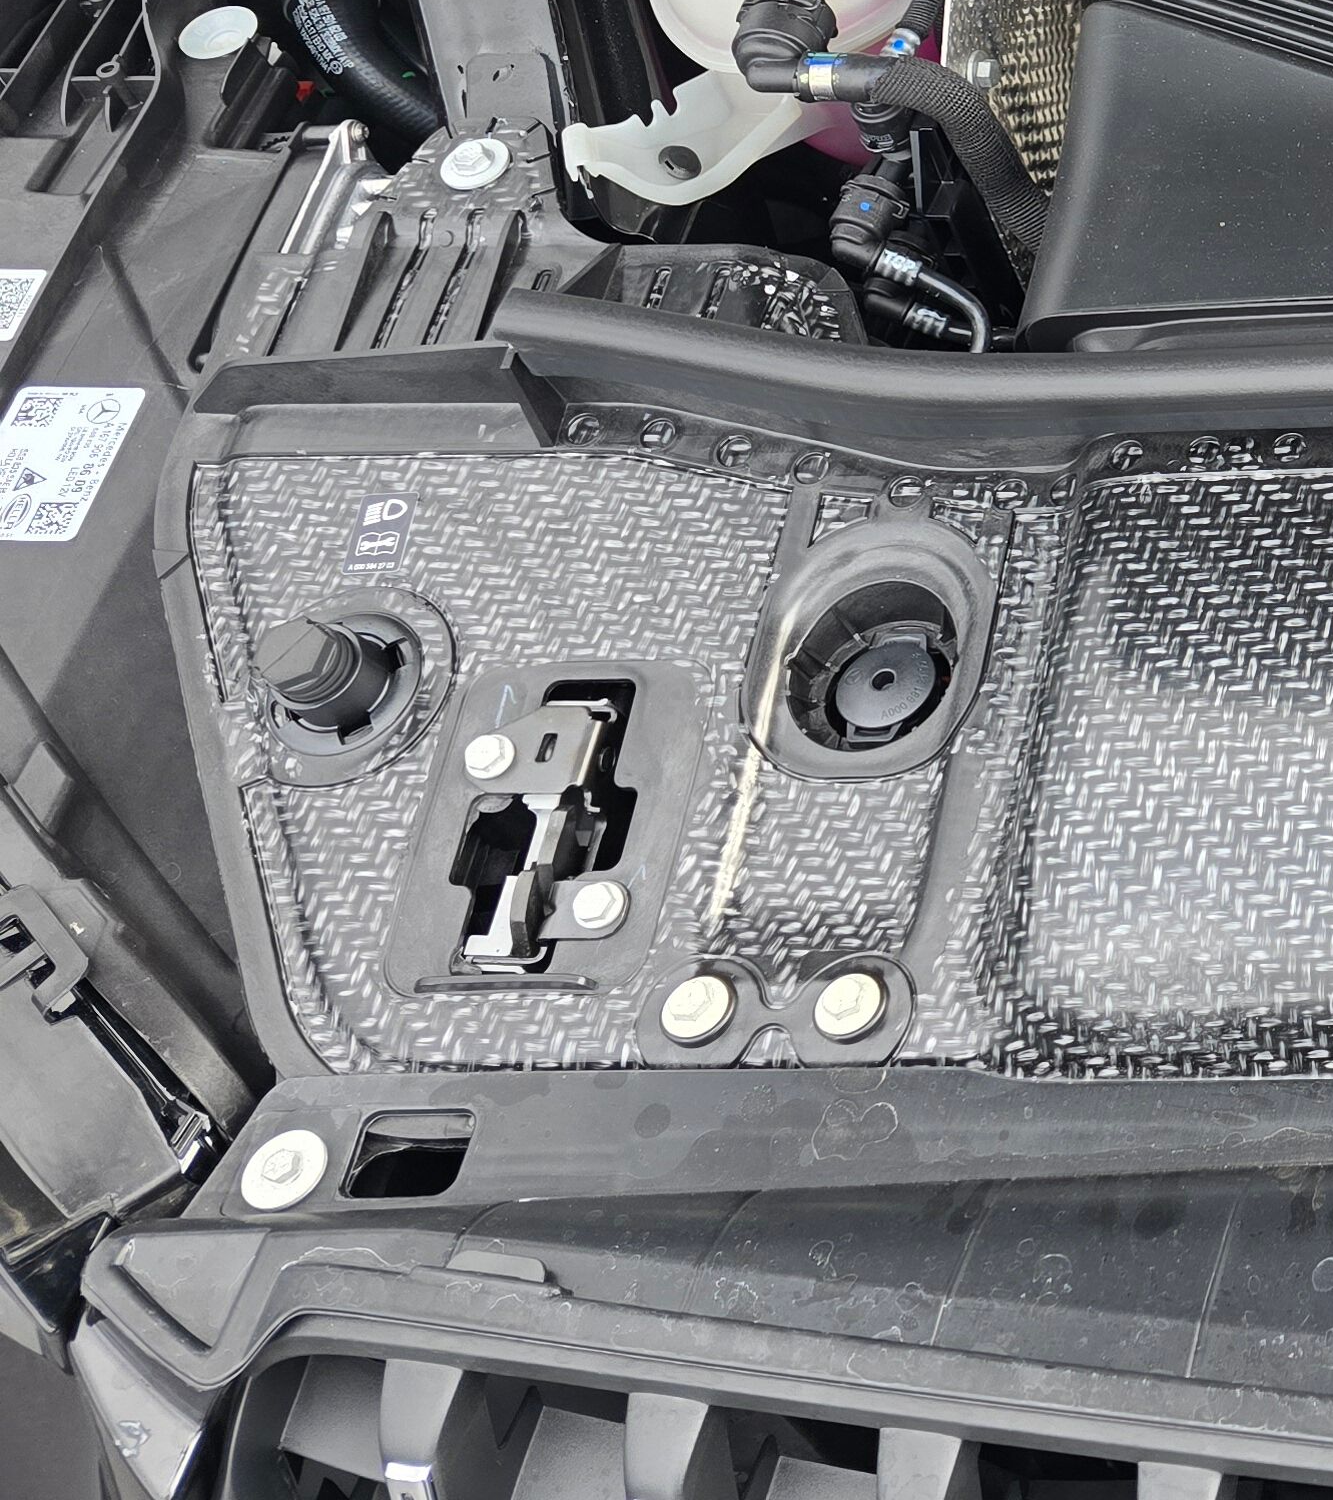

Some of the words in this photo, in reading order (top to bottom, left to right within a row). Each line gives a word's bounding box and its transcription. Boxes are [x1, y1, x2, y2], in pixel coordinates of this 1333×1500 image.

[96, 422, 127, 467] Mercedes
[70, 479, 86, 492] 09
[78, 478, 100, 501] Benz
[2, 496, 27, 529] HELLA
